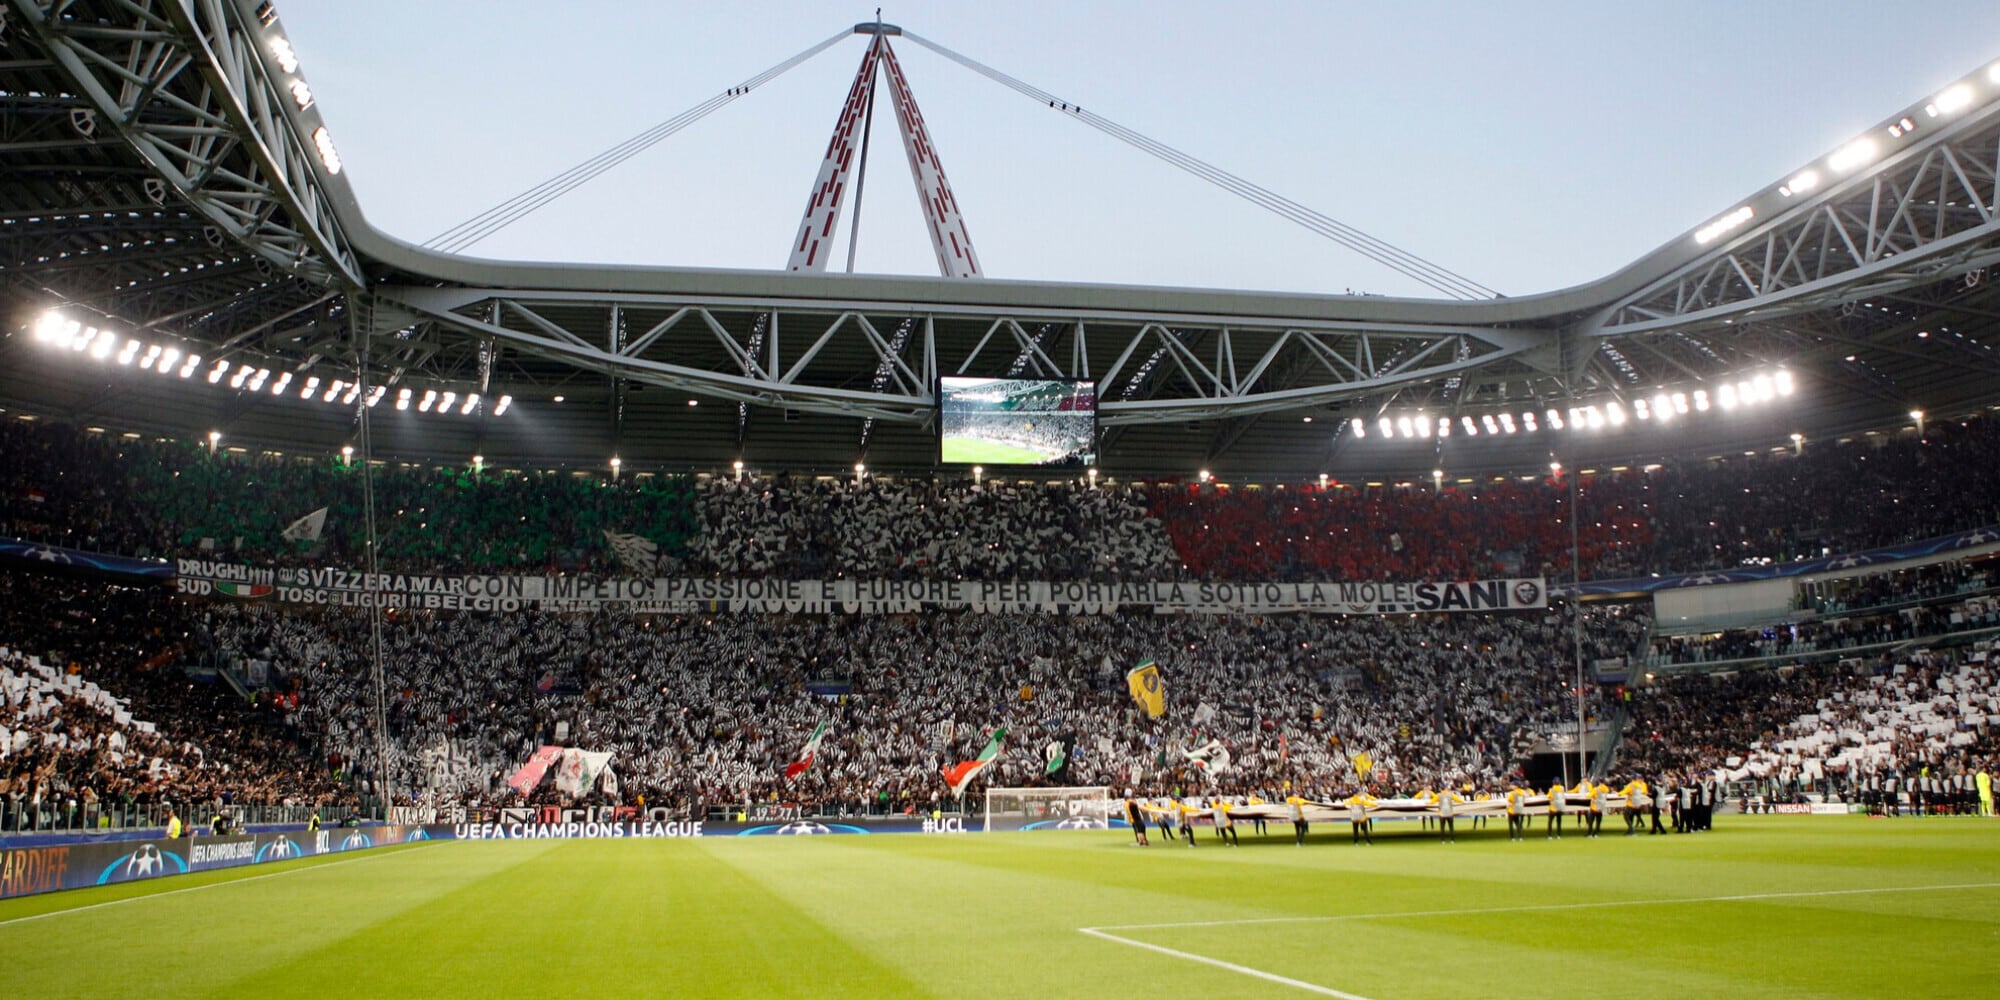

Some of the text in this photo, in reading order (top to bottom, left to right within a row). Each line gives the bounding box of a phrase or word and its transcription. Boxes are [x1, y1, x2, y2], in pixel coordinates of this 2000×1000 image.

[177, 558, 248, 581] DRUGHI
[297, 567, 408, 592] SVIZZERA
[177, 578, 212, 596] SUD
[465, 575, 524, 598] CON
[668, 577, 801, 600] PASSIONE
[823, 580, 837, 600] E
[856, 580, 962, 601] FURORE
[982, 580, 1031, 601] PER
[1050, 582, 1186, 603] PORTARLA
[1200, 583, 1281, 604] SOTTO
[1295, 583, 1325, 603] LA
[1341, 582, 1415, 604] MOLE!
[425, 594, 519, 613] BELGIO
[1778, 804, 1810, 813] NISSAN
[456, 821, 703, 839] UEFA CHAMPIONS LEAGUE
[922, 817, 966, 834] #UCL
[192, 844, 206, 863] UEFA
[206, 842, 237, 862] CHAMPIONS
[0, 847, 70, 896] ARDIFF
